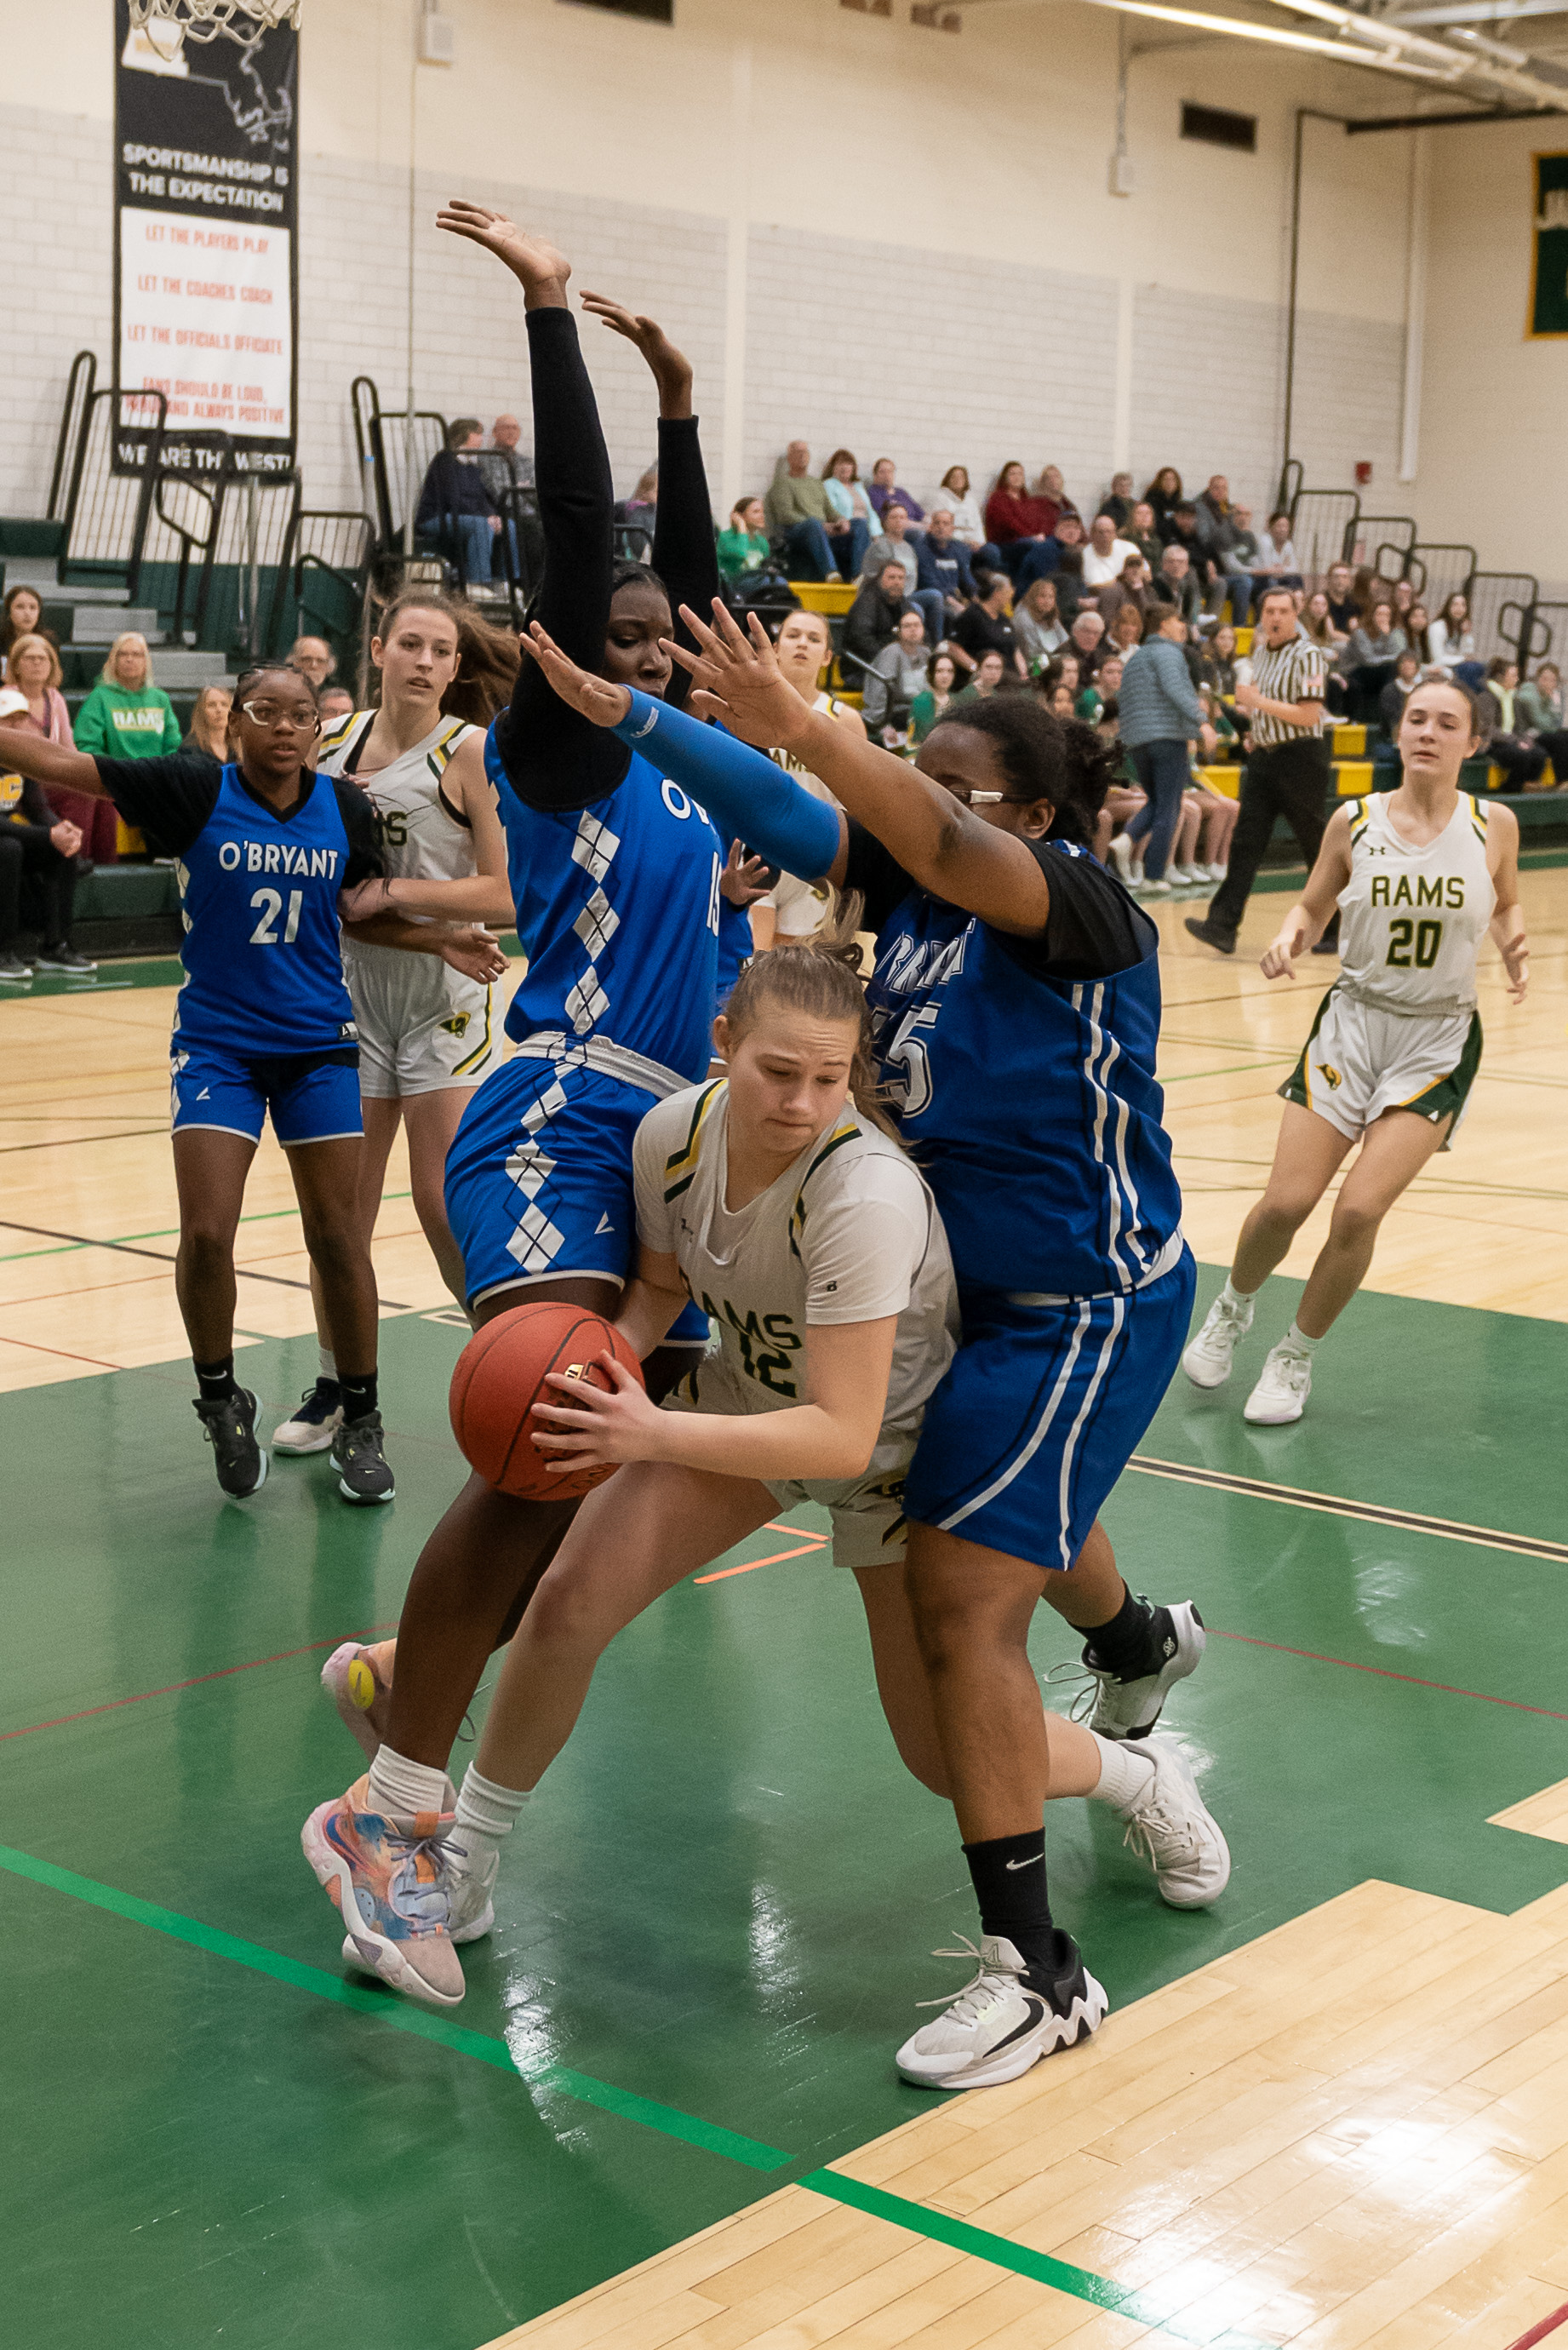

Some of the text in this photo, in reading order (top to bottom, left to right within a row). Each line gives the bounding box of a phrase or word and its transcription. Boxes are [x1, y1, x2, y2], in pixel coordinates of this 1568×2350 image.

[123, 143, 289, 186] SPORTSMANSHIP IS
[130, 172, 283, 212] THE EXPECTATION
[146, 225, 164, 241] LET
[171, 226, 188, 245] THE
[194, 231, 238, 251] PLAYERS
[138, 274, 157, 292] LET
[163, 277, 181, 295] THE
[186, 280, 235, 301] COACHES
[128, 324, 146, 342] LET
[152, 326, 170, 345] THE
[176, 330, 231, 350] OFFICIALS
[194, 449, 224, 470] TH
[219, 840, 338, 880] O'BRYANT
[1371, 874, 1465, 910] RAMS
[249, 886, 303, 944] 21
[1385, 917, 1443, 969] 20
